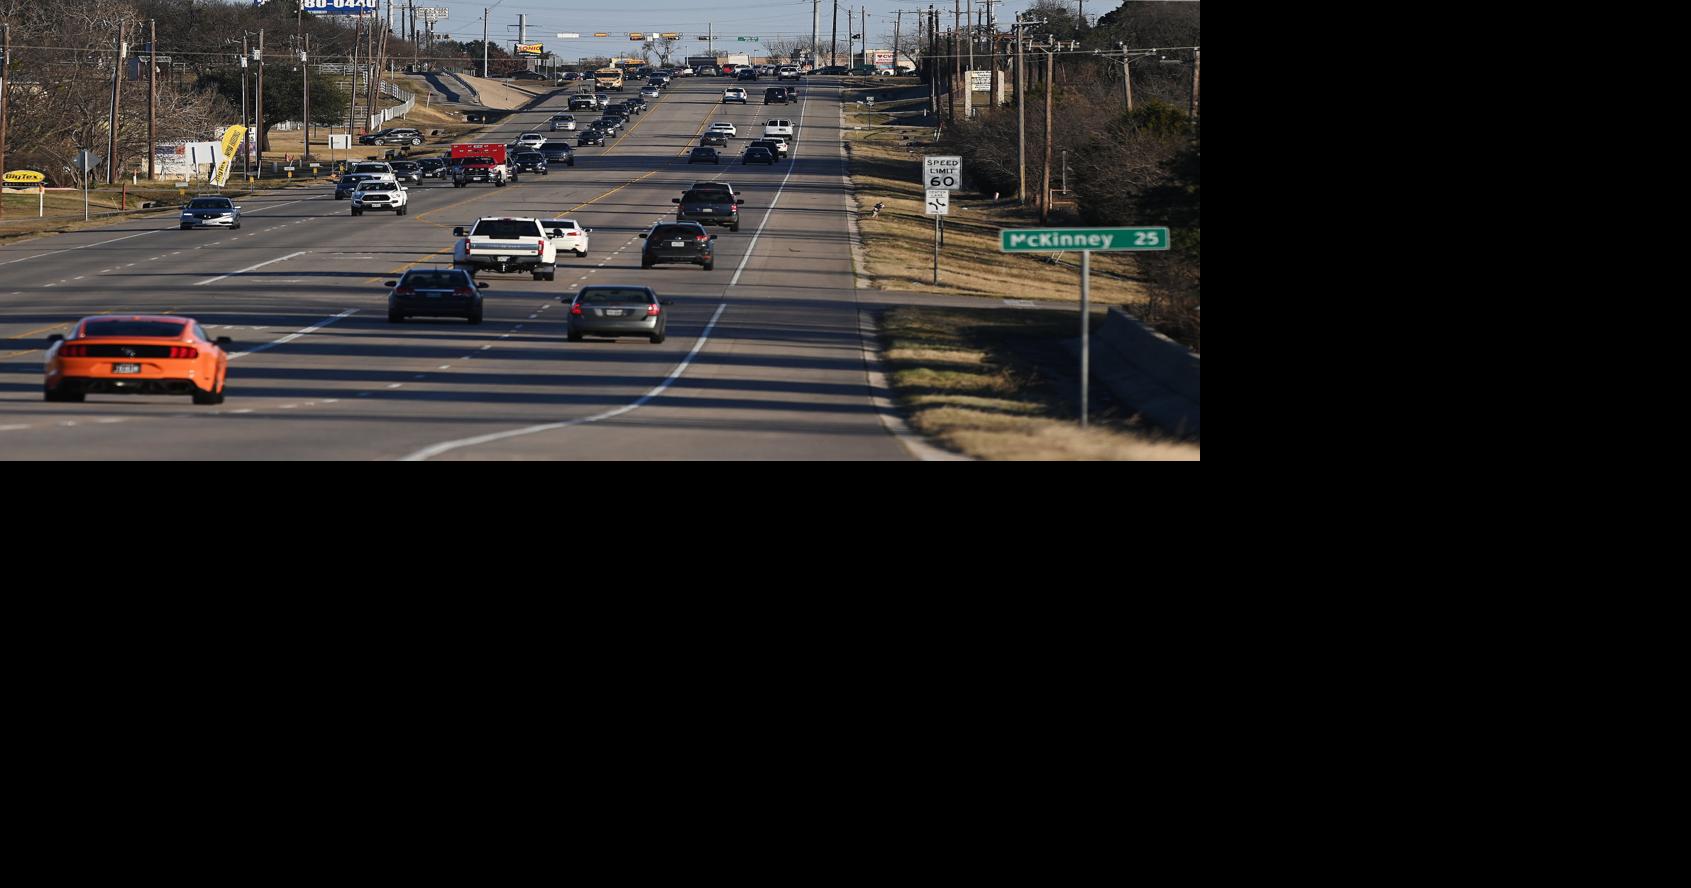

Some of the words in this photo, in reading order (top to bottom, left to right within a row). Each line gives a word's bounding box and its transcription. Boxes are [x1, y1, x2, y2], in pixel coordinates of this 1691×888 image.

[930, 176, 955, 187] 60
[1010, 233, 1113, 248] McKinney
[1134, 231, 1160, 246] 25
